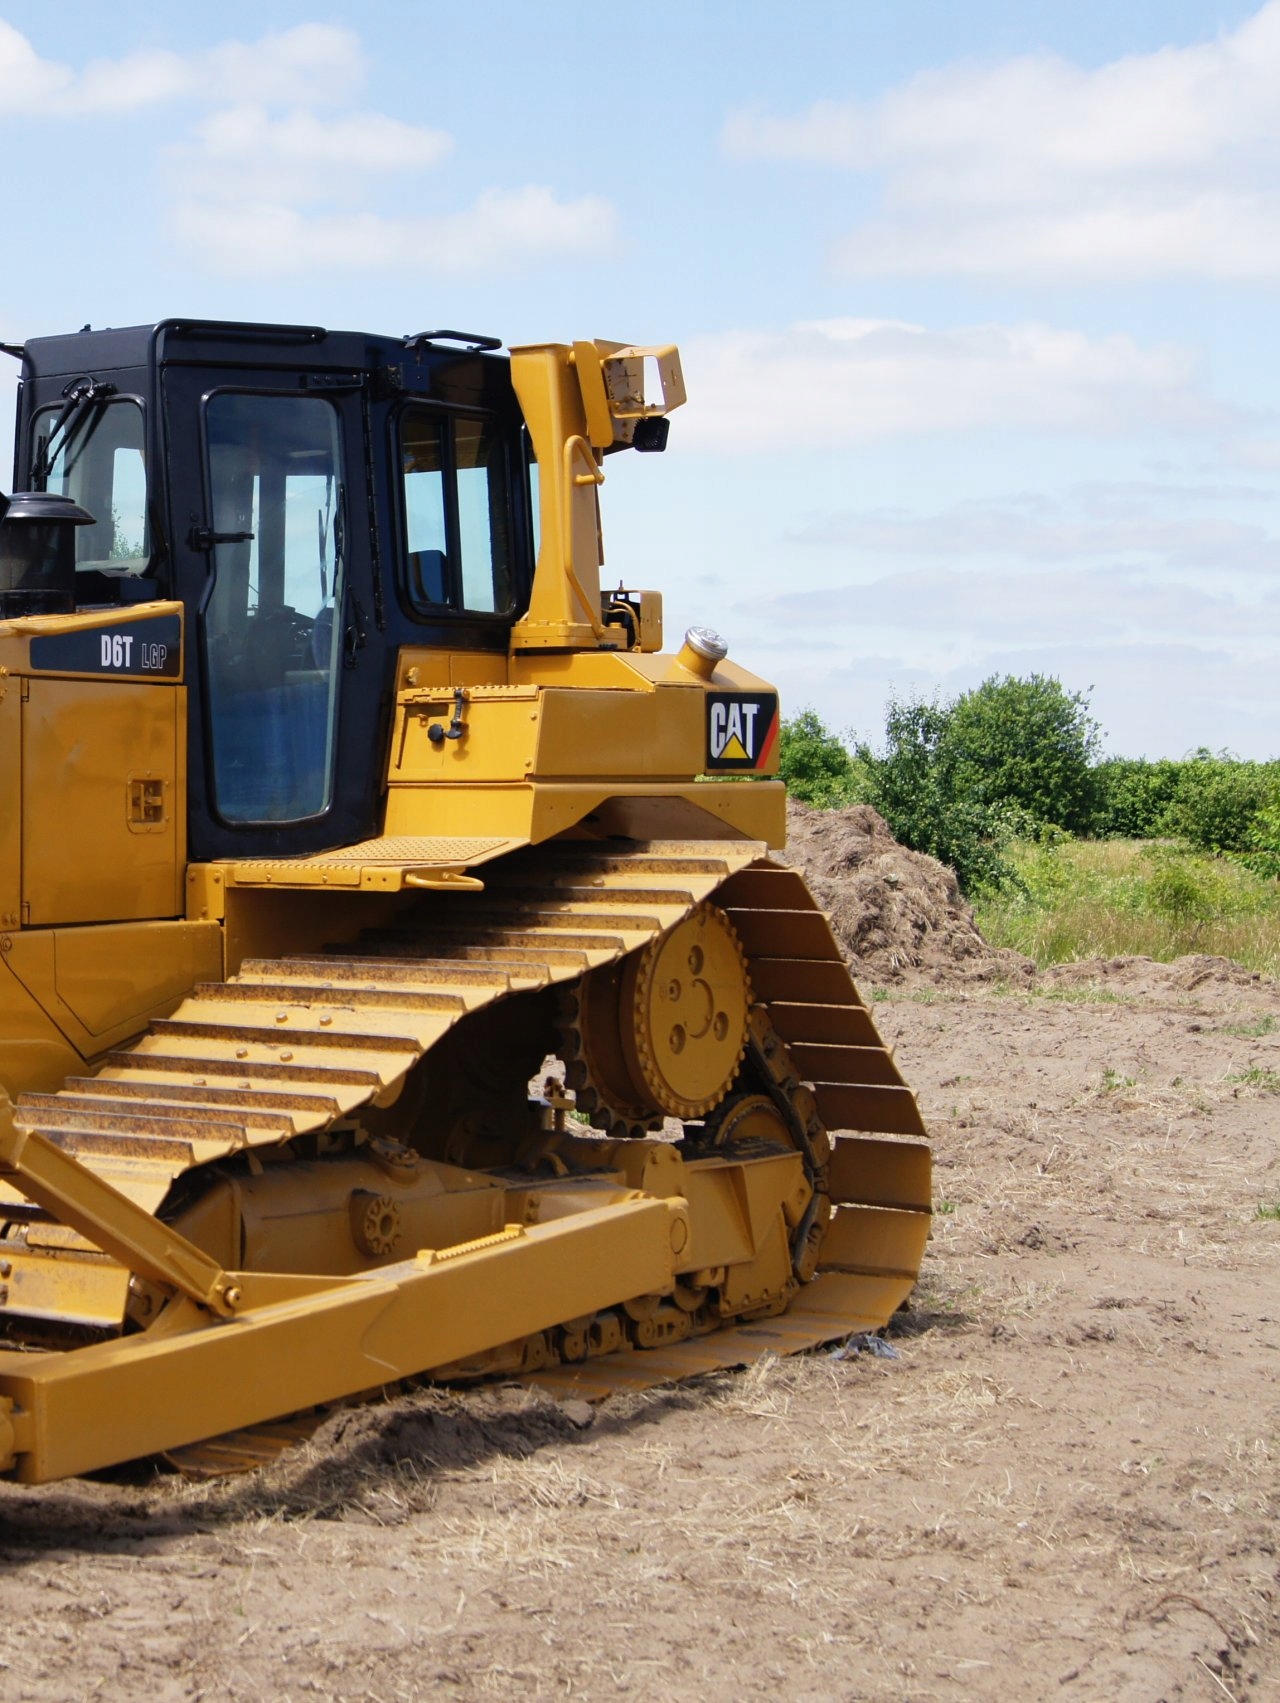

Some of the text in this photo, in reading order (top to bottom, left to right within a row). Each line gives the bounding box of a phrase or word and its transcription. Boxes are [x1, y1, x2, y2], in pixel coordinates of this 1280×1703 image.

[101, 635, 167, 669] D6T LGP
[710, 702, 758, 759] CAT
